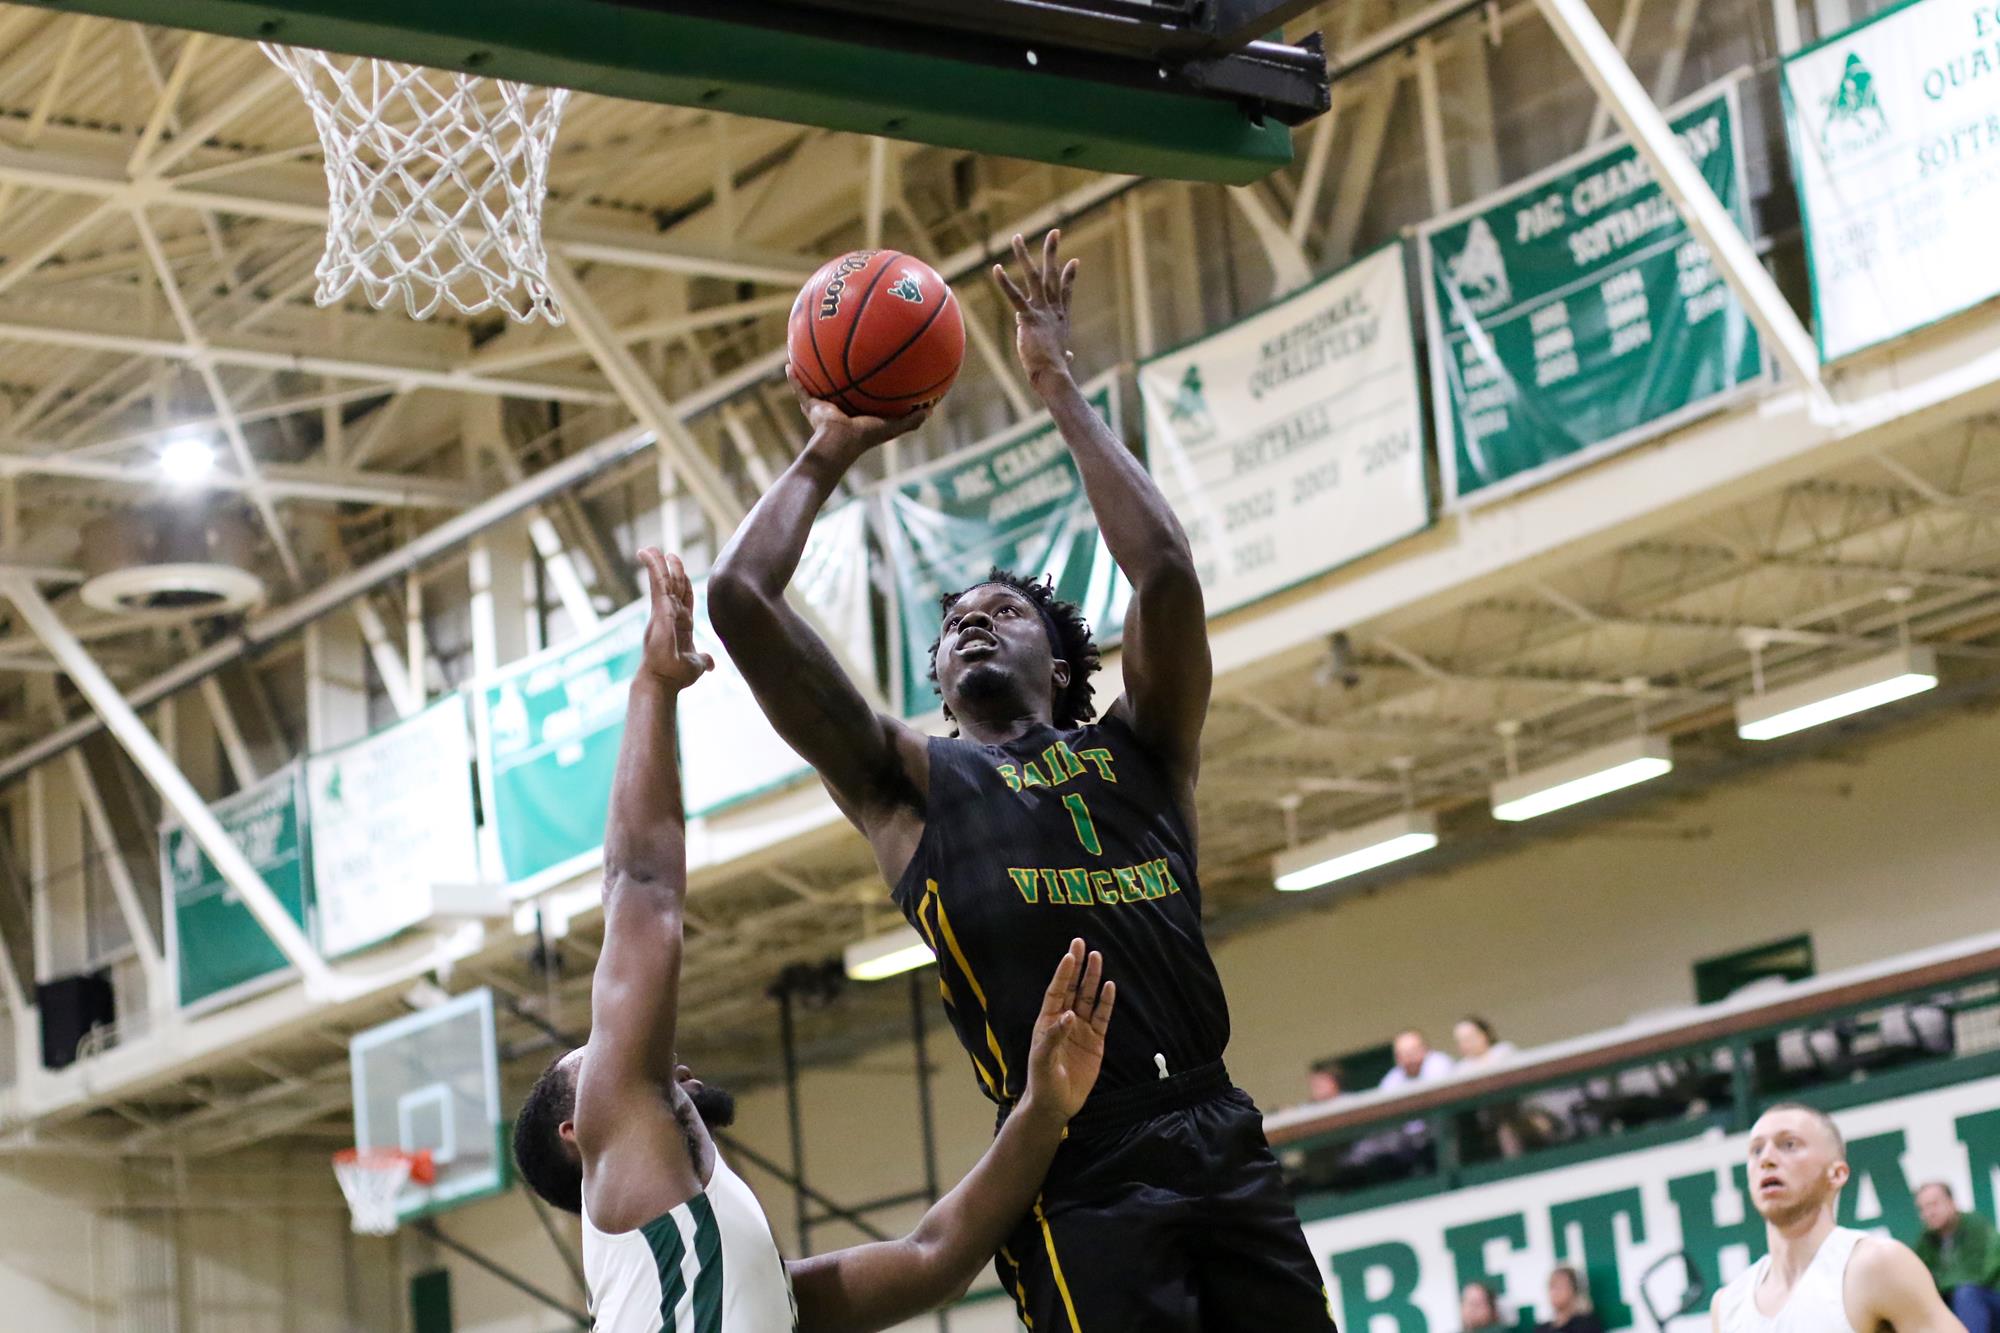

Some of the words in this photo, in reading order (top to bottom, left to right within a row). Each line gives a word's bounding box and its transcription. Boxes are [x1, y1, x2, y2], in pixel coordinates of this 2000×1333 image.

[1973, 3, 2000, 38] E
[1923, 40, 2000, 101] QUA
[819, 249, 878, 321] ilson
[1062, 793, 1102, 856] 1
